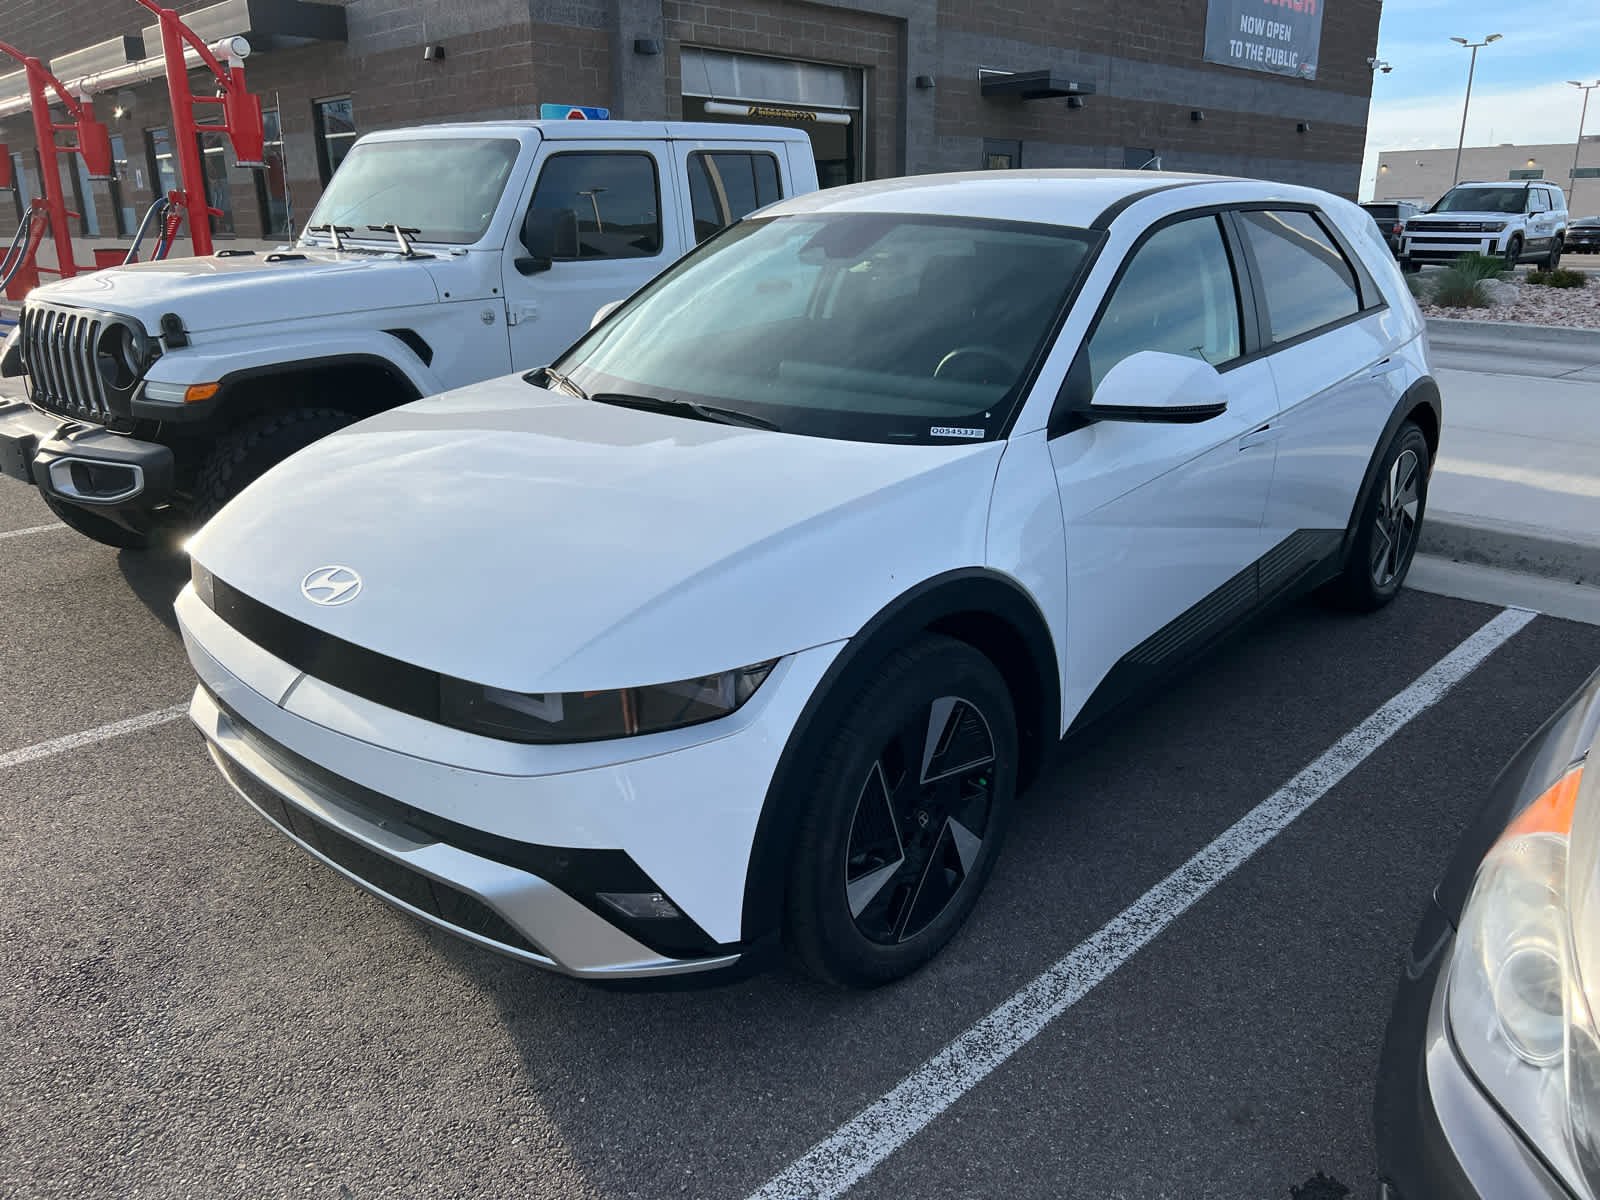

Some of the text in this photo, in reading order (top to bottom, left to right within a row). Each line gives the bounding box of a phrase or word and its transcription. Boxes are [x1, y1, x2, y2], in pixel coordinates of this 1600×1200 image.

[1240, 15, 1292, 41] NOW OPEN
[1230, 40, 1243, 58] TO
[1245, 42, 1265, 62] THE
[1265, 46, 1298, 68] PUBLIC
